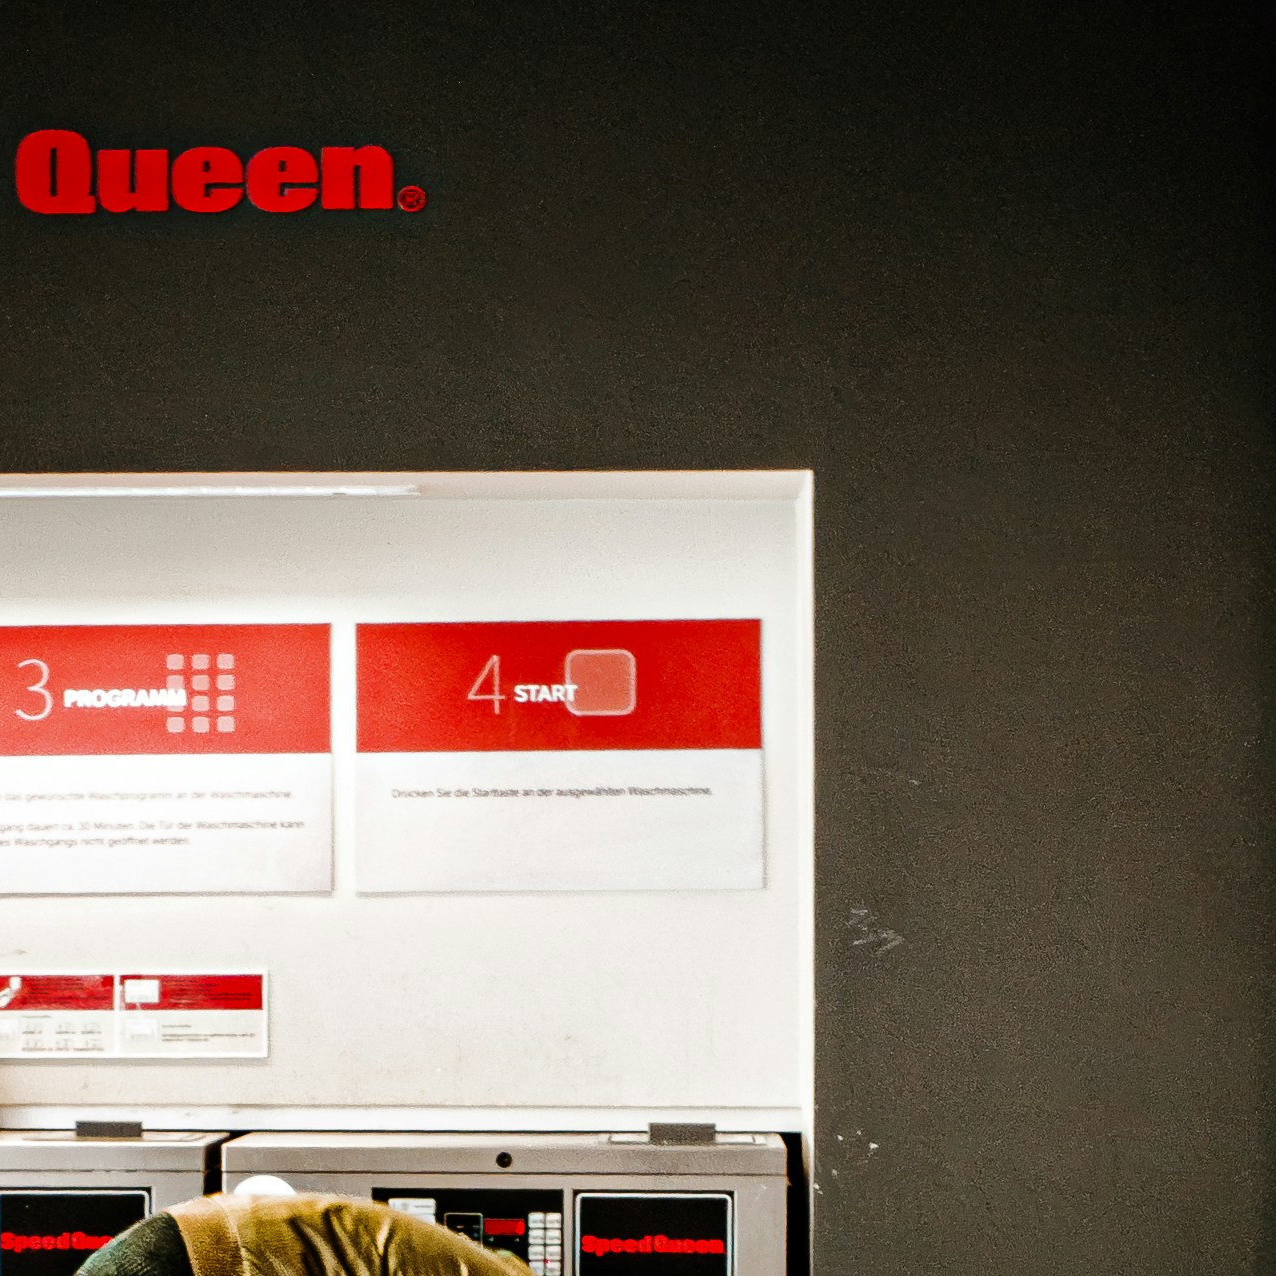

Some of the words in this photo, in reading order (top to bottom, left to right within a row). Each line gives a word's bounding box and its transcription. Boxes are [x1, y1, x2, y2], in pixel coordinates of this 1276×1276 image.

[15, 658, 53, 721] 3
[467, 654, 505, 715] 4
[513, 683, 578, 703] START
[0, 1232, 70, 1253] Speed
[581, 1235, 651, 1256] Speed
